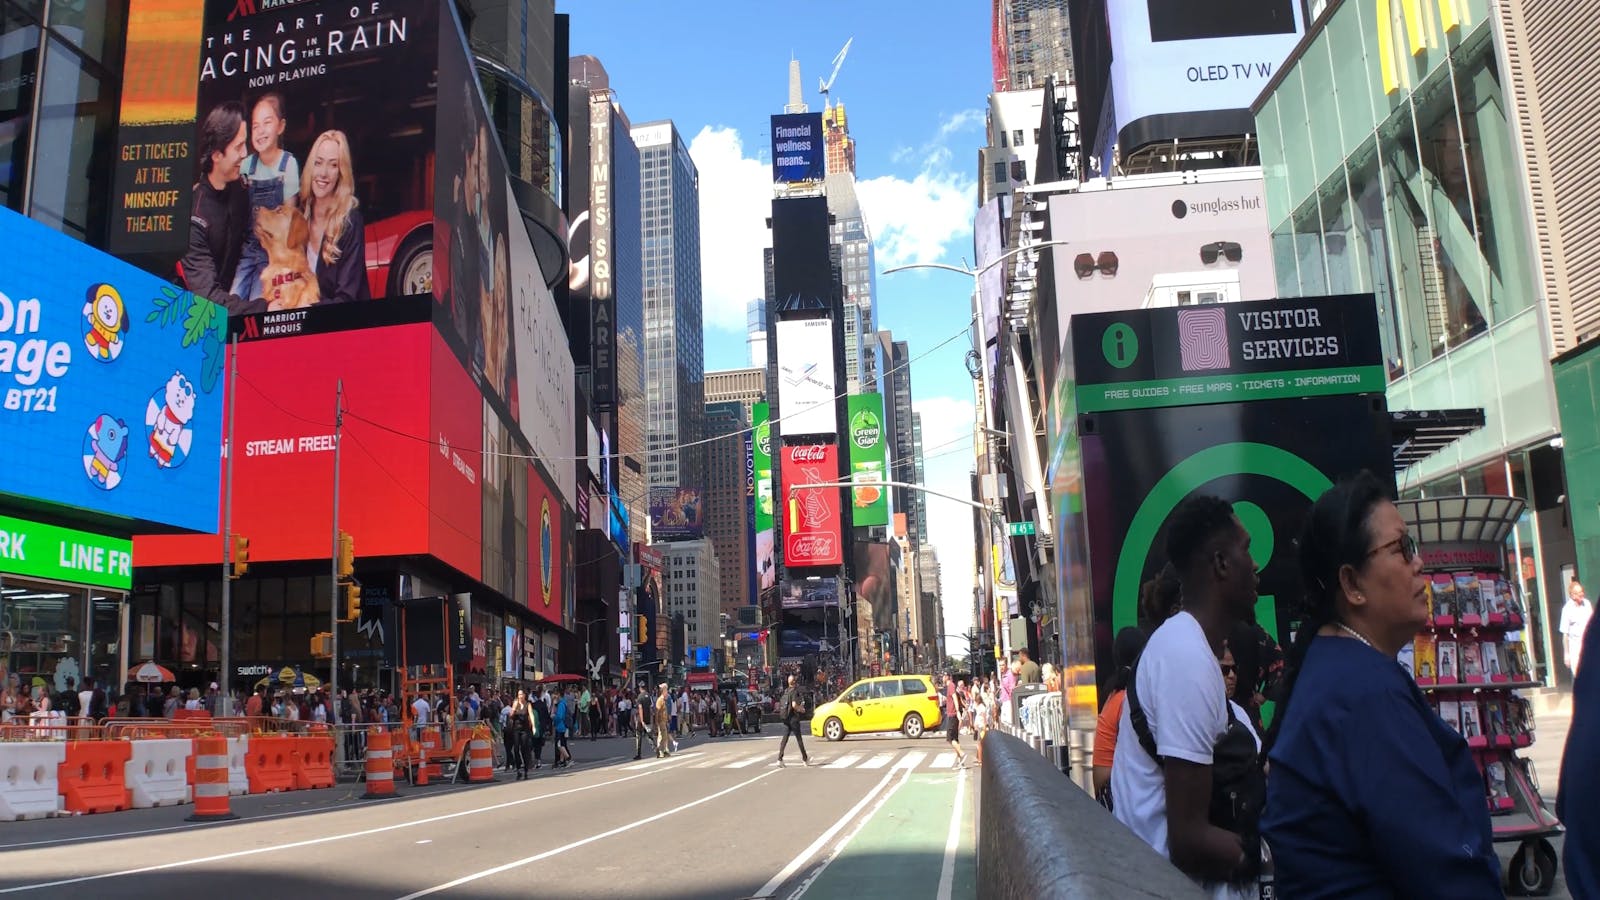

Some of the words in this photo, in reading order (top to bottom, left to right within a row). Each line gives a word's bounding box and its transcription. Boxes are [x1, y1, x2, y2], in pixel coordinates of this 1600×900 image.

[207, 29, 251, 49] THE
[275, 14, 323, 34] ART
[350, 2, 379, 18] OF
[306, 37, 317, 46] IN
[328, 17, 406, 56] RAIN
[199, 40, 297, 82] ACING
[302, 48, 321, 58] THE
[249, 74, 275, 89] NOW
[278, 64, 327, 83] PLAYING
[1187, 65, 1228, 82] OLED
[1232, 63, 1252, 79] TV
[1256, 62, 1271, 78] W
[775, 124, 812, 138] Financial
[122, 144, 143, 161] GET
[144, 142, 189, 160] TICKETS
[776, 139, 812, 153] wellness
[776, 155, 811, 167] means...
[134, 167, 149, 185] AT
[151, 166, 172, 183] THE
[592, 121, 608, 227] TIMES
[124, 190, 180, 209] MINSKOFF
[1190, 197, 1240, 216] sunglass
[1241, 195, 1260, 210] hut
[126, 214, 173, 233] THEATRE
[594, 238, 611, 369] SQUARE
[263, 311, 308, 324] MARRIOTT
[1238, 308, 1321, 331] VISITOR
[263, 323, 302, 335] MARQUIS
[1242, 336, 1339, 360] SERVICES
[1104, 389, 1130, 400] FREE
[1132, 386, 1169, 398] GUIDES
[1179, 384, 1205, 395] FREE
[1207, 382, 1233, 392] MAPS
[1242, 379, 1285, 390] TICKETS
[1294, 374, 1361, 387] INFORMATION
[4, 386, 58, 412] BT21
[854, 428, 878, 437] Green
[857, 436, 879, 446] Giant
[245, 438, 294, 457] STREAM
[791, 444, 825, 461] Coca-Cola
[745, 435, 754, 496] NOVOTEL
[1011, 524, 1017, 535] W
[1019, 524, 1027, 535] 45
[792, 538, 832, 557] Coca-Cola
[59, 541, 105, 573] LINE
[108, 549, 131, 577] FR
[237, 664, 268, 676] swatch
